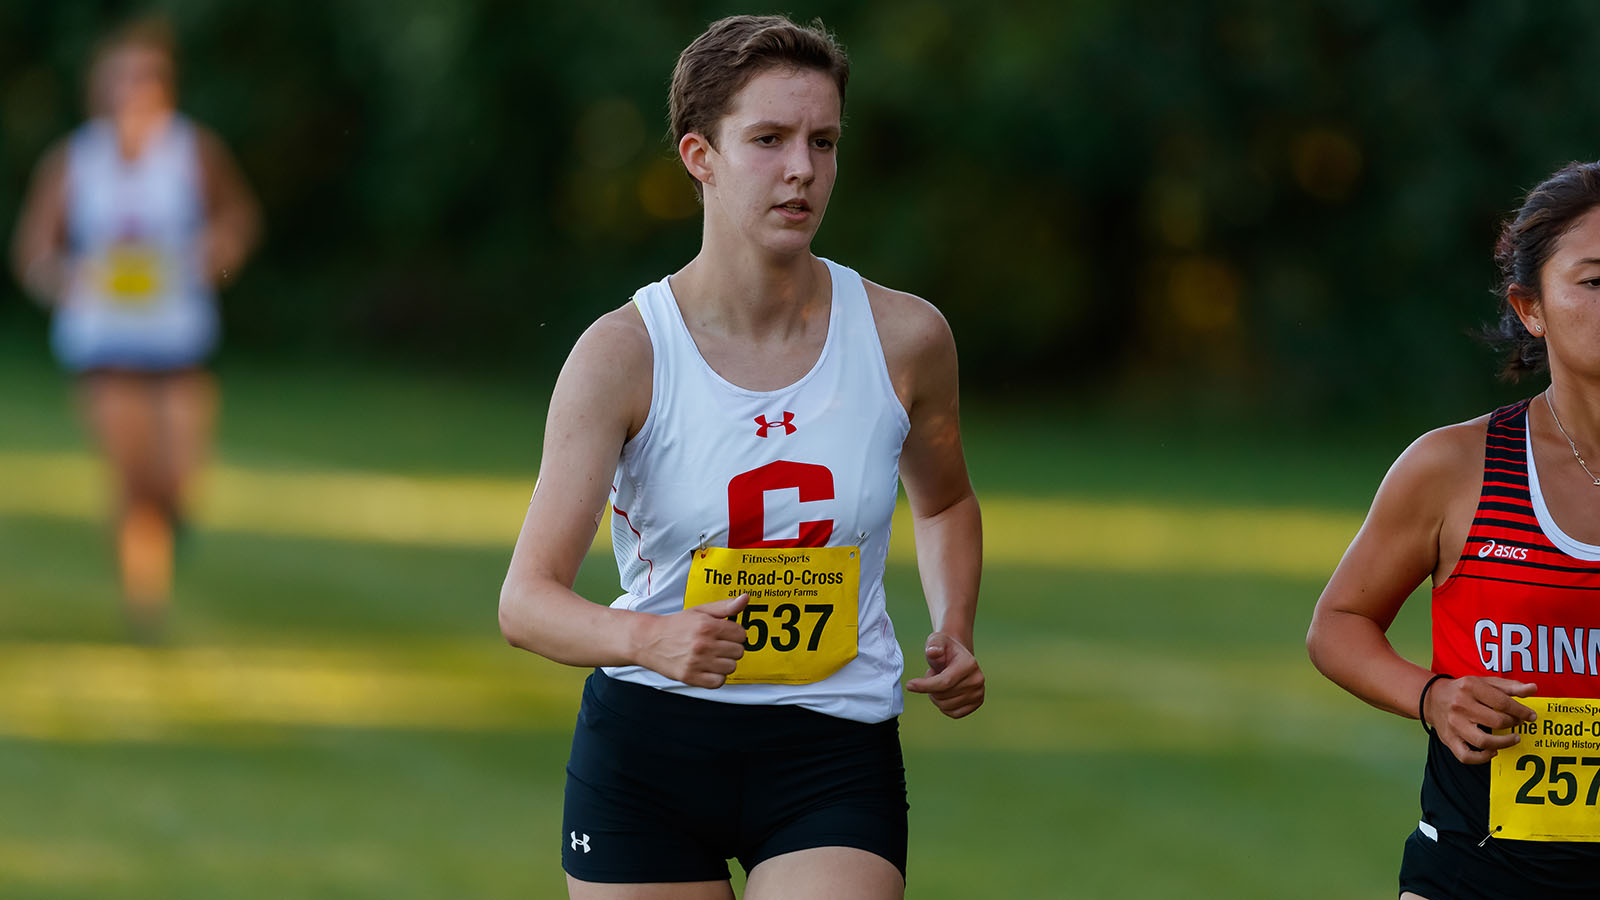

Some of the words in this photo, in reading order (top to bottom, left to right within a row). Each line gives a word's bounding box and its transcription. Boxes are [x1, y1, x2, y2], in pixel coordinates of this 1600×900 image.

[742, 554, 810, 565] FitnessSports
[1494, 545, 1528, 560] asics
[704, 568, 732, 585] The
[737, 569, 843, 586] Road-O-Cross
[728, 589, 737, 597] at
[764, 589, 792, 598] History
[793, 588, 818, 597] Farms
[726, 603, 834, 652] 537
[1511, 720, 1538, 735] he
[1534, 740, 1543, 748] at
[1545, 739, 1570, 750] Living
[1571, 740, 1600, 751] History
